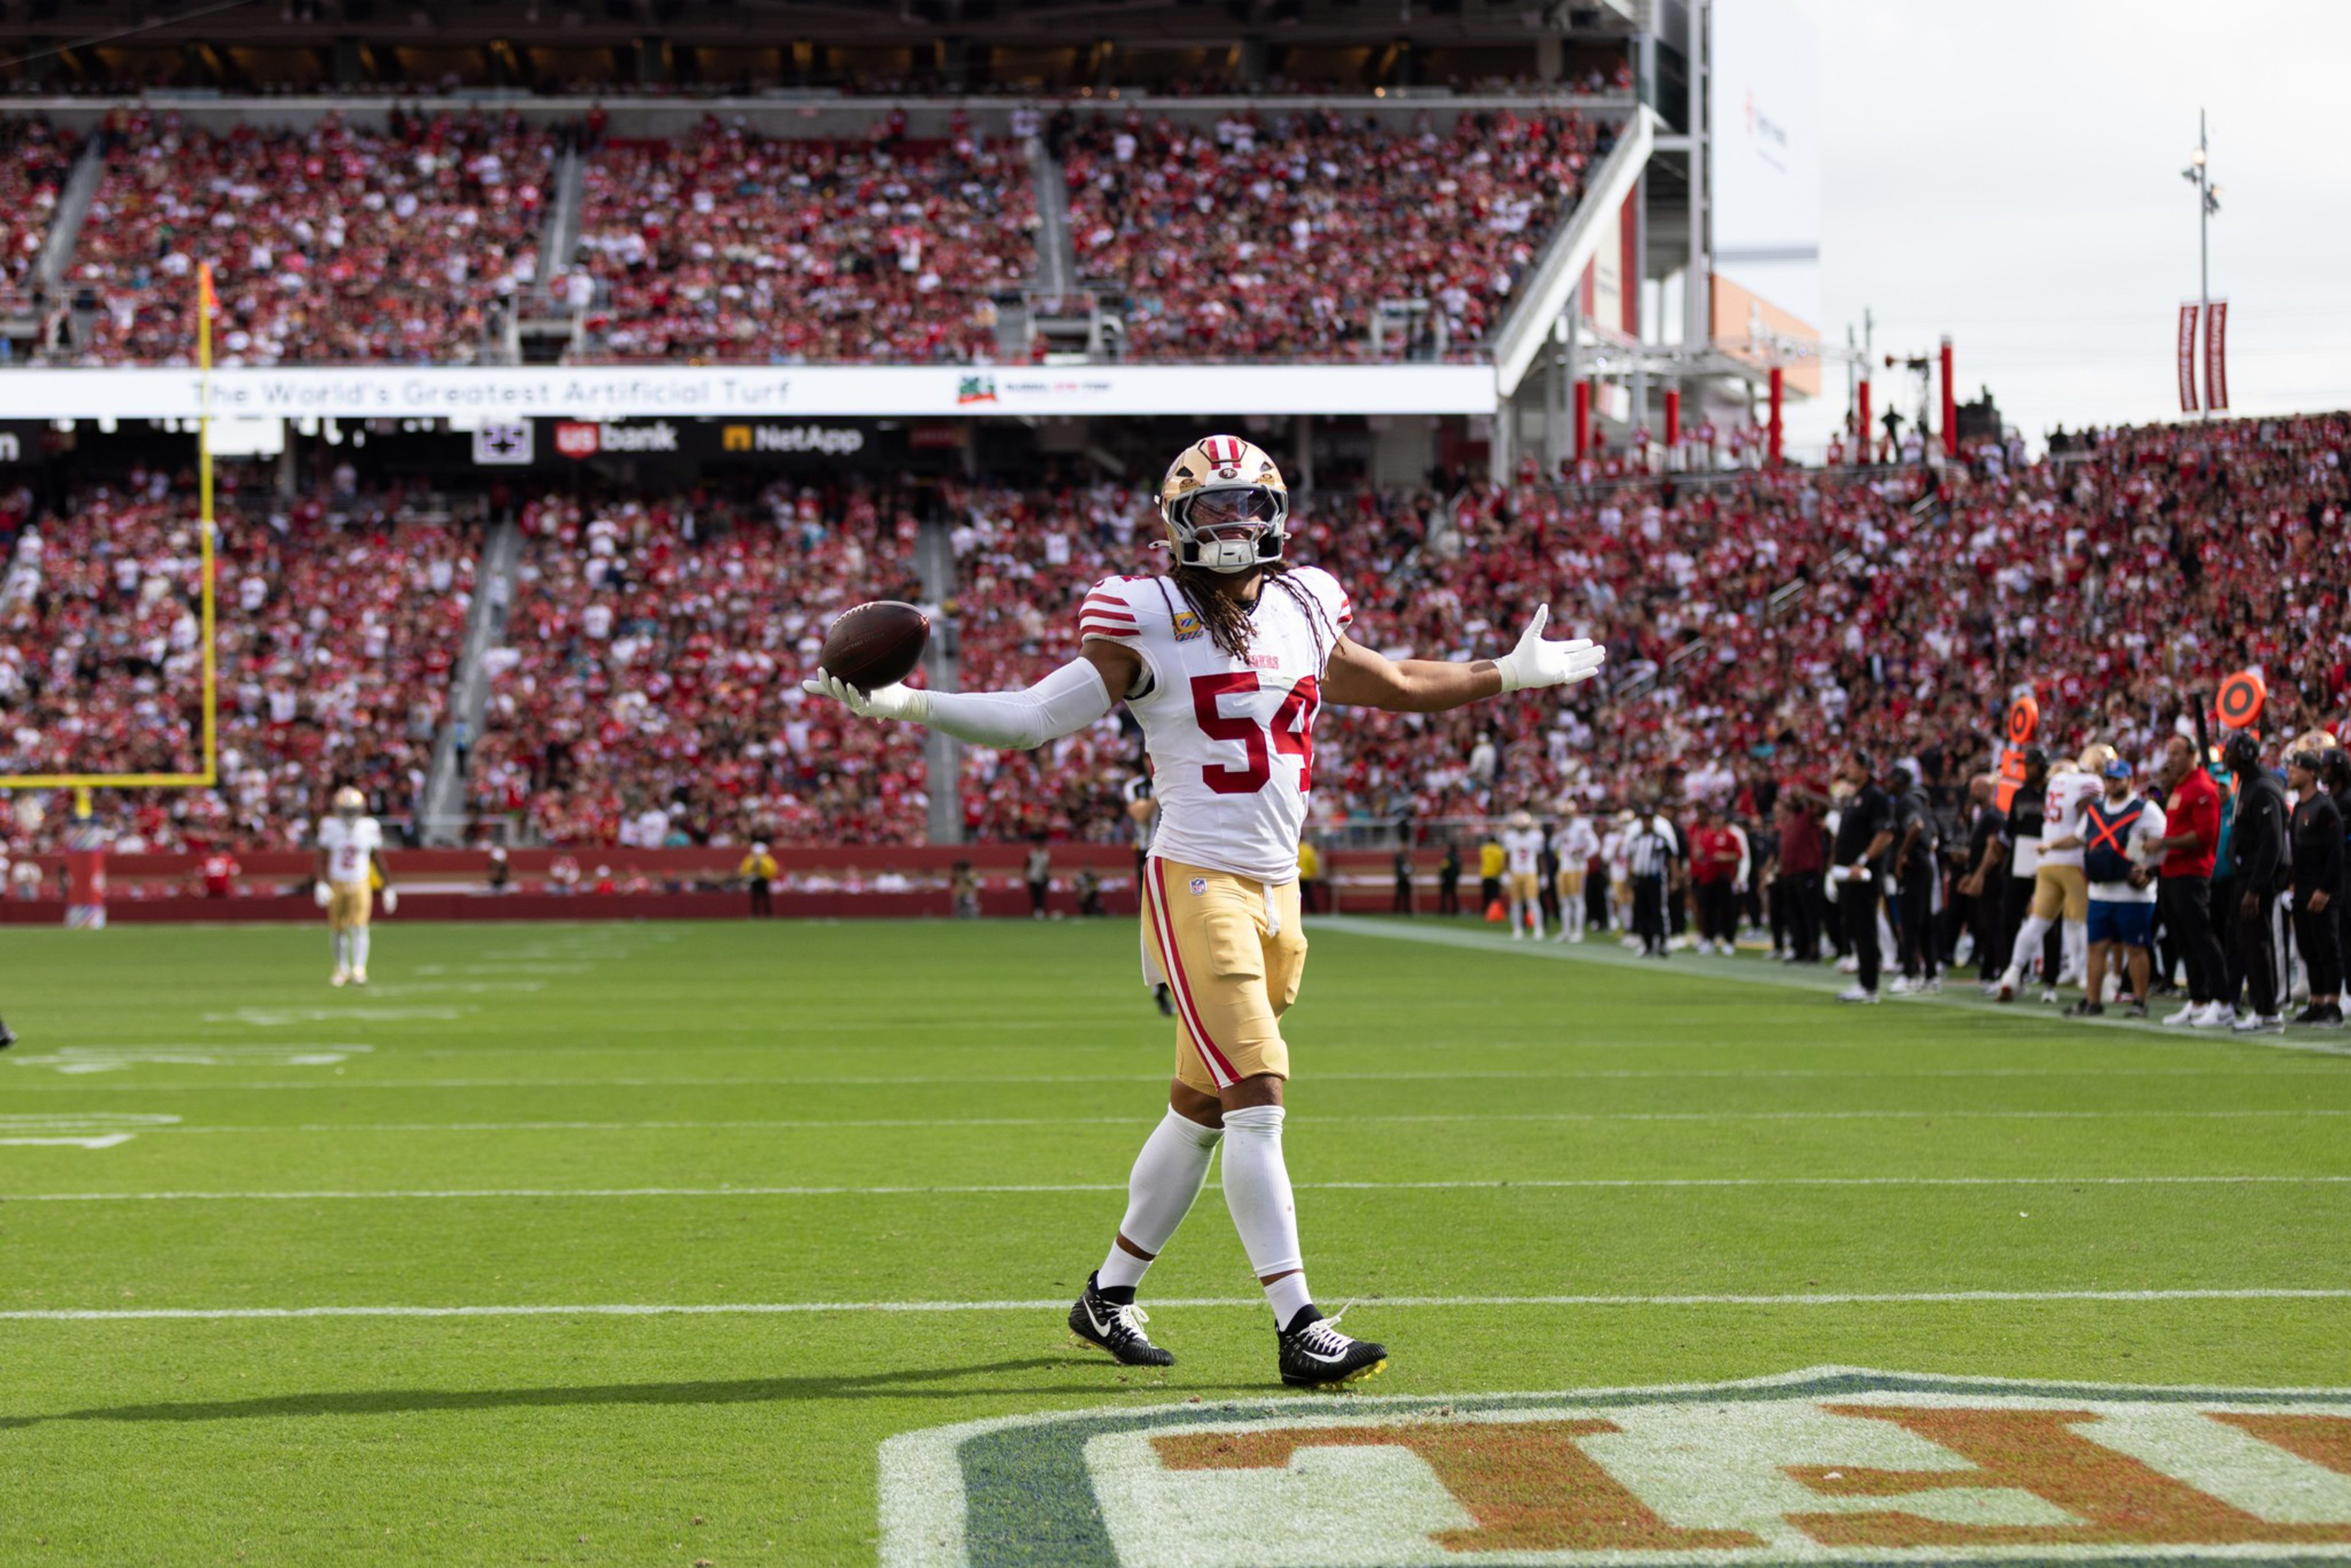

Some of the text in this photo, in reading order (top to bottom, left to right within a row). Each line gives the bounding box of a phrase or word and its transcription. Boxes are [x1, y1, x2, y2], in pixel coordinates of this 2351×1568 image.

[262, 380, 389, 403] World's
[402, 380, 549, 403] Greatest
[563, 379, 709, 403] Artificial
[723, 378, 790, 403] Turf
[600, 421, 678, 451] bank
[755, 425, 863, 455] NetApp
[1190, 672, 1318, 794] 54
[1150, 1404, 2351, 1550] FL
